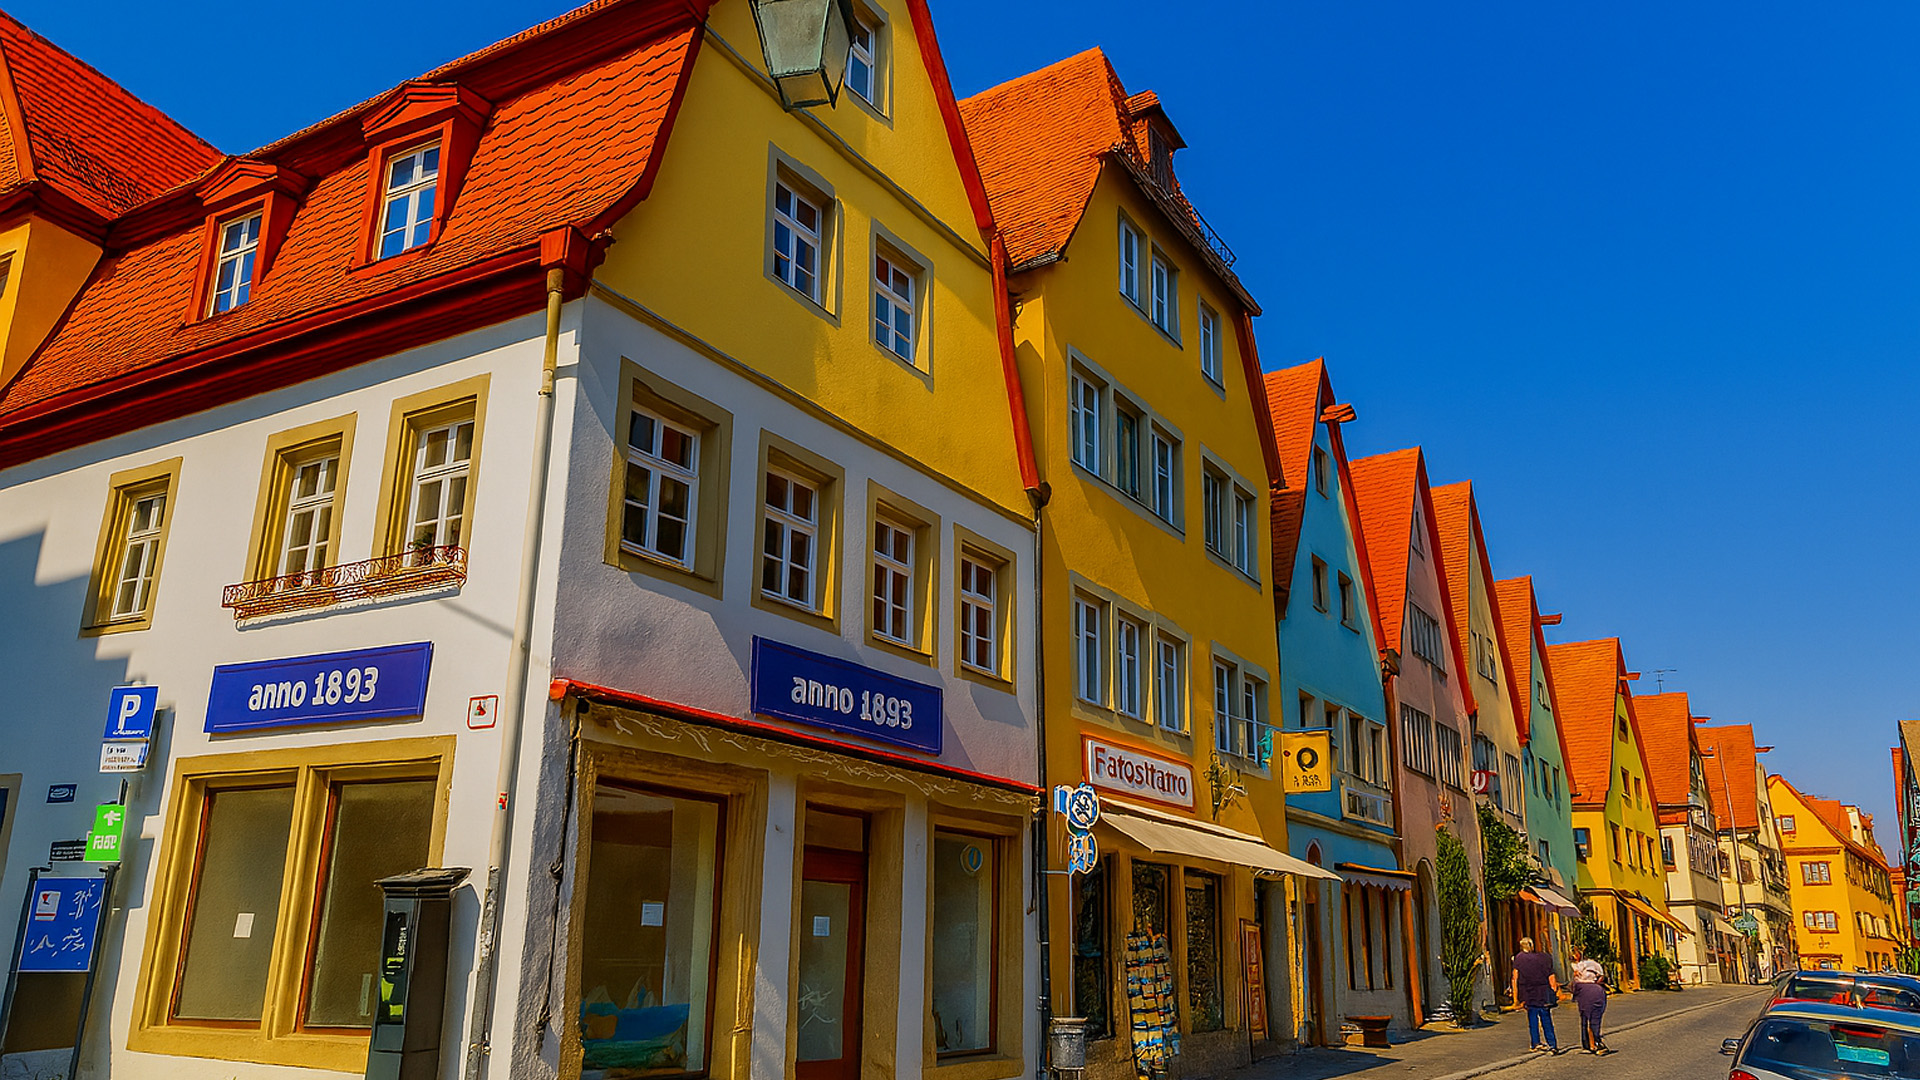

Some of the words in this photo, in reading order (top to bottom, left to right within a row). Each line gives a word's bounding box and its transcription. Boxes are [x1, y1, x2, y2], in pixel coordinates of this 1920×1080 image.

[249, 680, 307, 711] anno
[311, 666, 379, 706] 1893
[791, 676, 855, 715] anno
[860, 690, 912, 730] 1893
[118, 694, 141, 730] P
